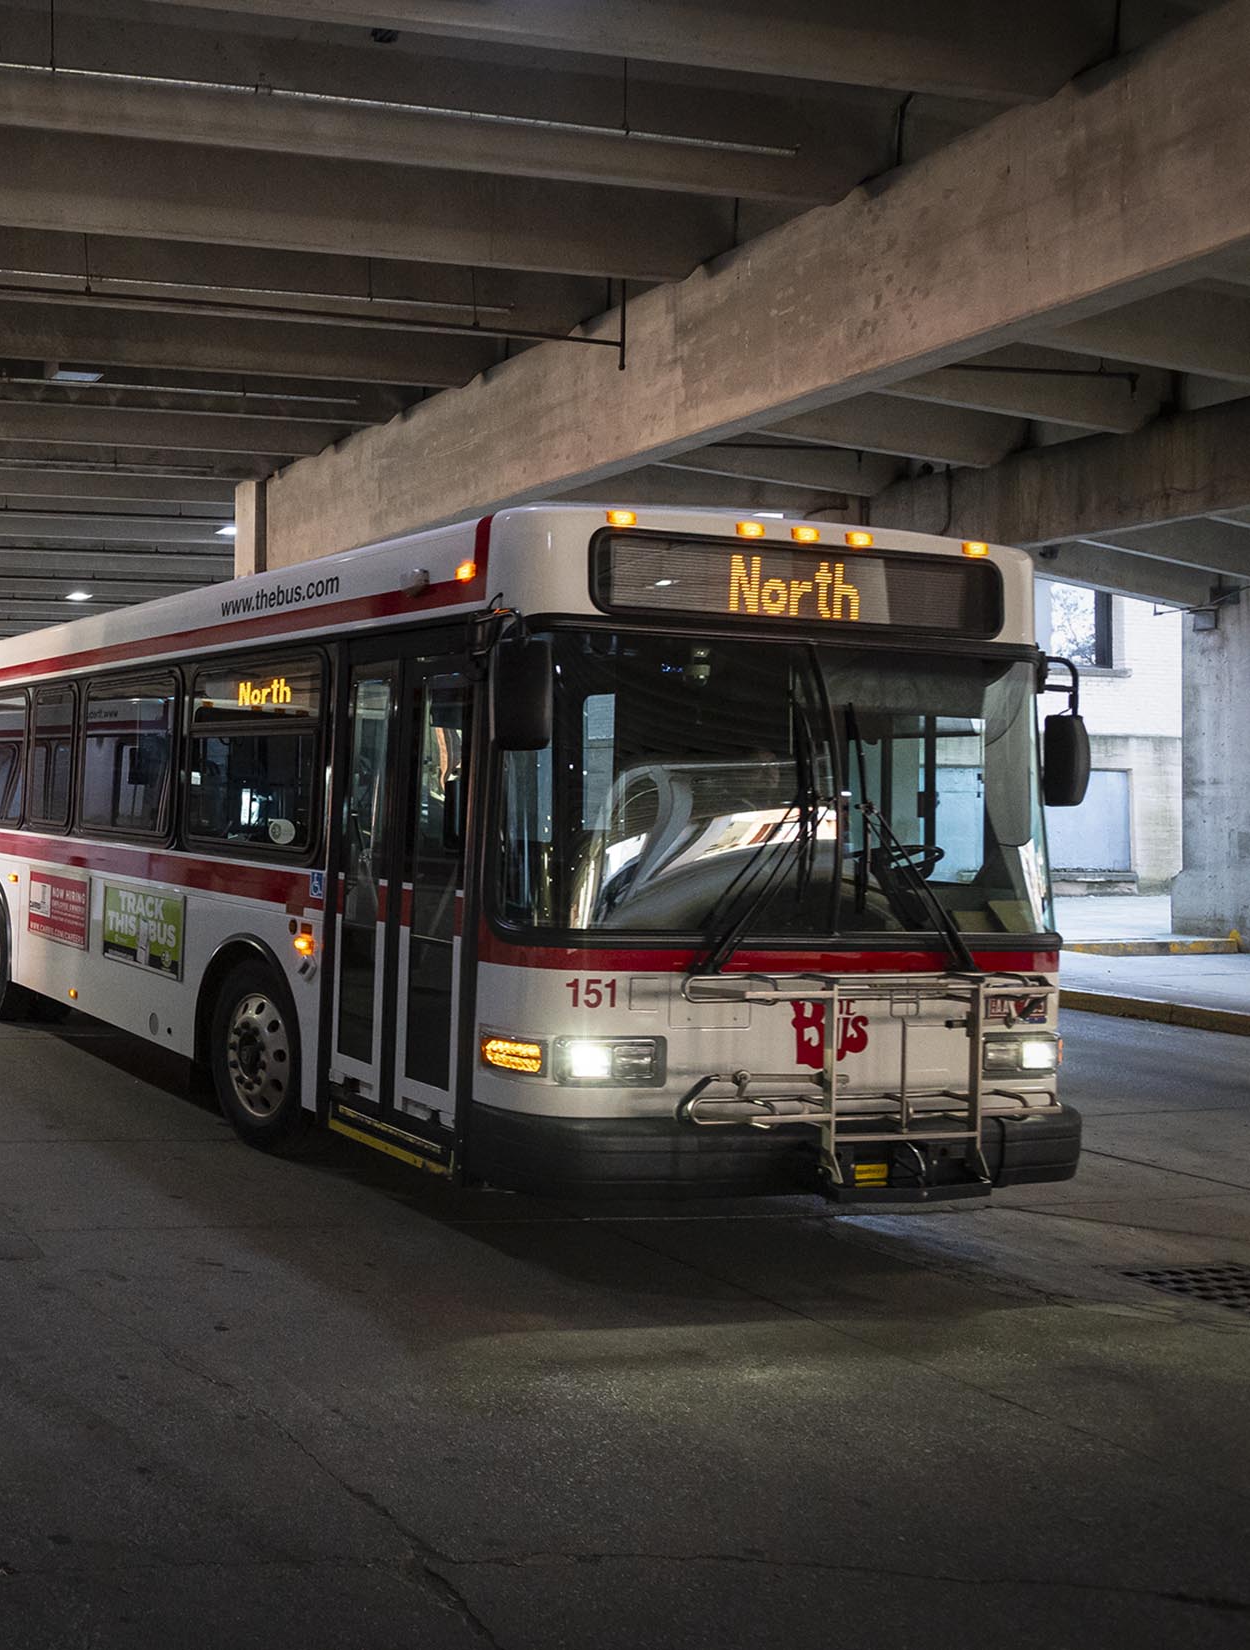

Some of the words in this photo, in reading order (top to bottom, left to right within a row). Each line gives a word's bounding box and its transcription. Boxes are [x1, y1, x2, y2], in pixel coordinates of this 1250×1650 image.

[221, 575, 340, 617] www.thebus.com
[729, 555, 860, 620] North
[238, 678, 291, 707] North
[118, 890, 165, 920] TRACK
[108, 910, 137, 936] THIS
[149, 920, 177, 948] BUS
[566, 978, 616, 1008] 151
